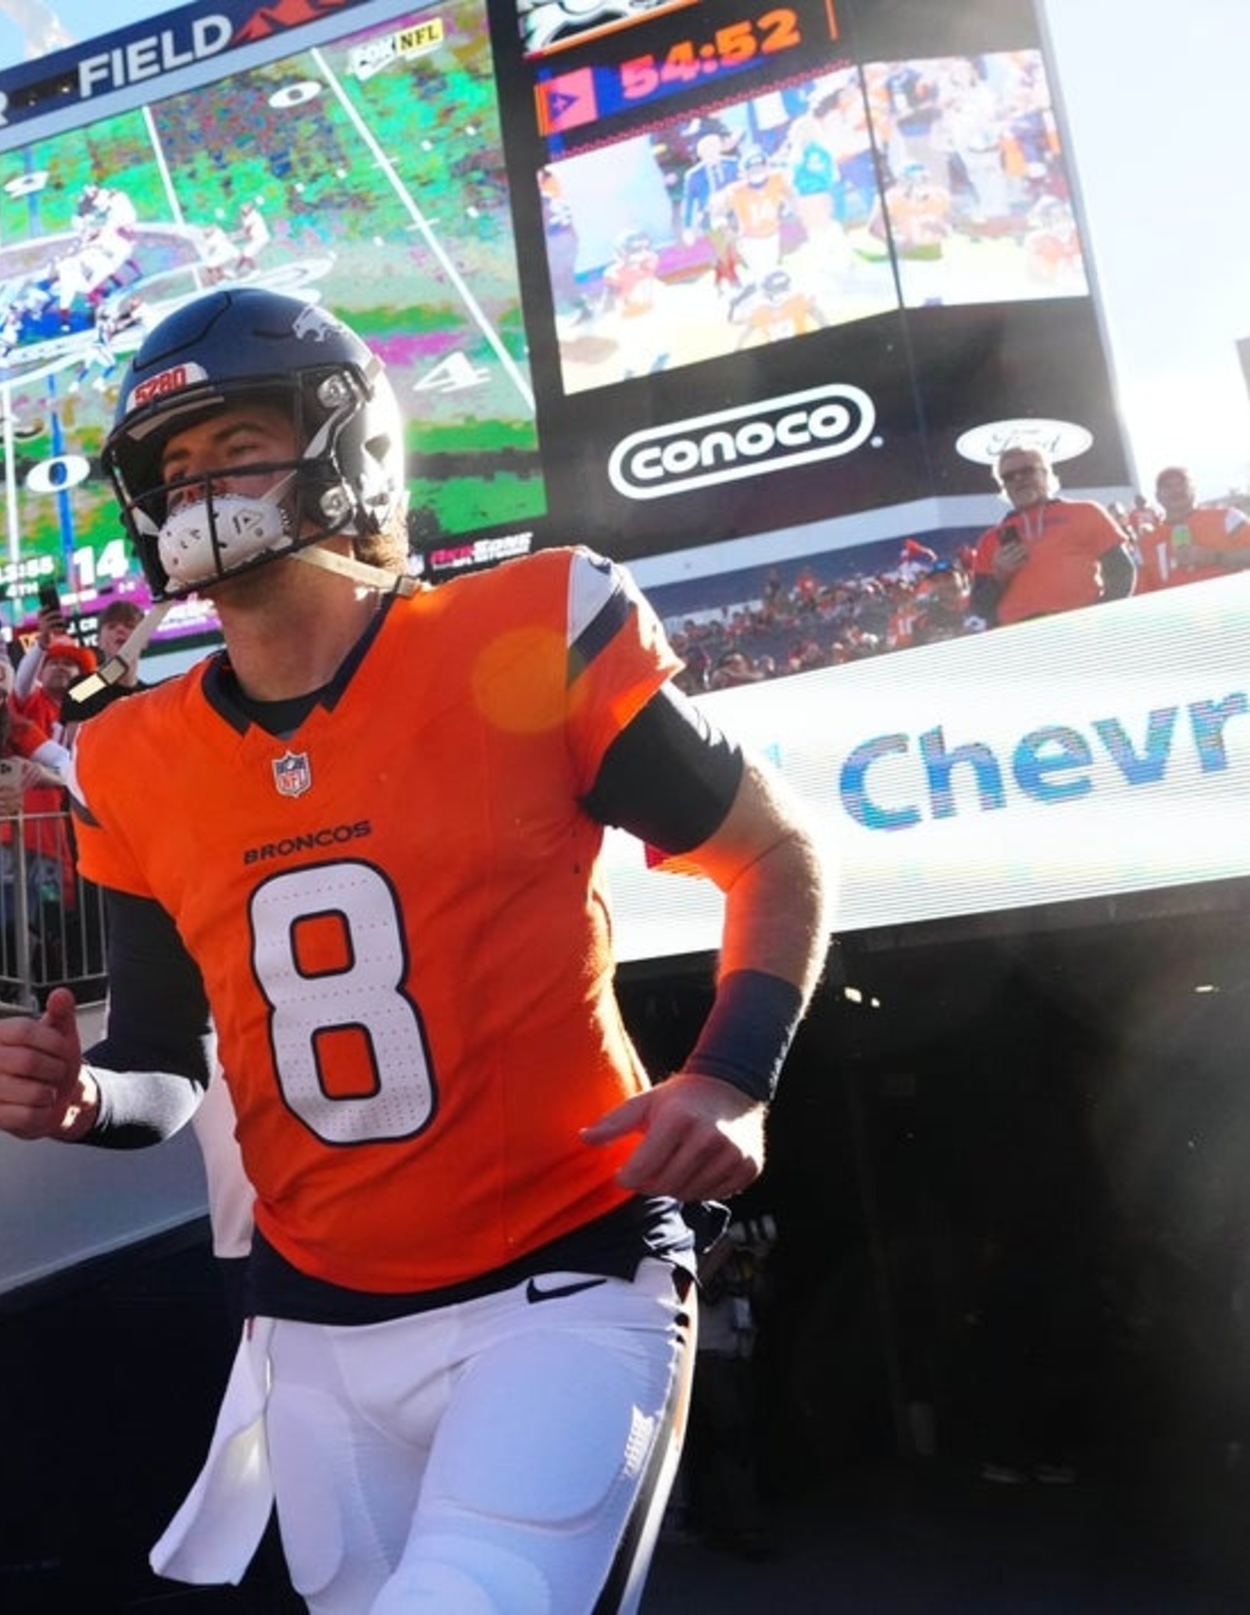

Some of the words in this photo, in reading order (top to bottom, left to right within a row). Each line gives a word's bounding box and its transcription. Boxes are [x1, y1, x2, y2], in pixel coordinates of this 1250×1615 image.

[78, 14, 233, 99] FIELD
[400, 24, 439, 50] NFL
[620, 8, 801, 98] 54:52
[73, 538, 129, 587] 14
[839, 692, 1250, 832] Chevr
[244, 820, 372, 865] BRONCOS
[246, 856, 440, 1147] 8
